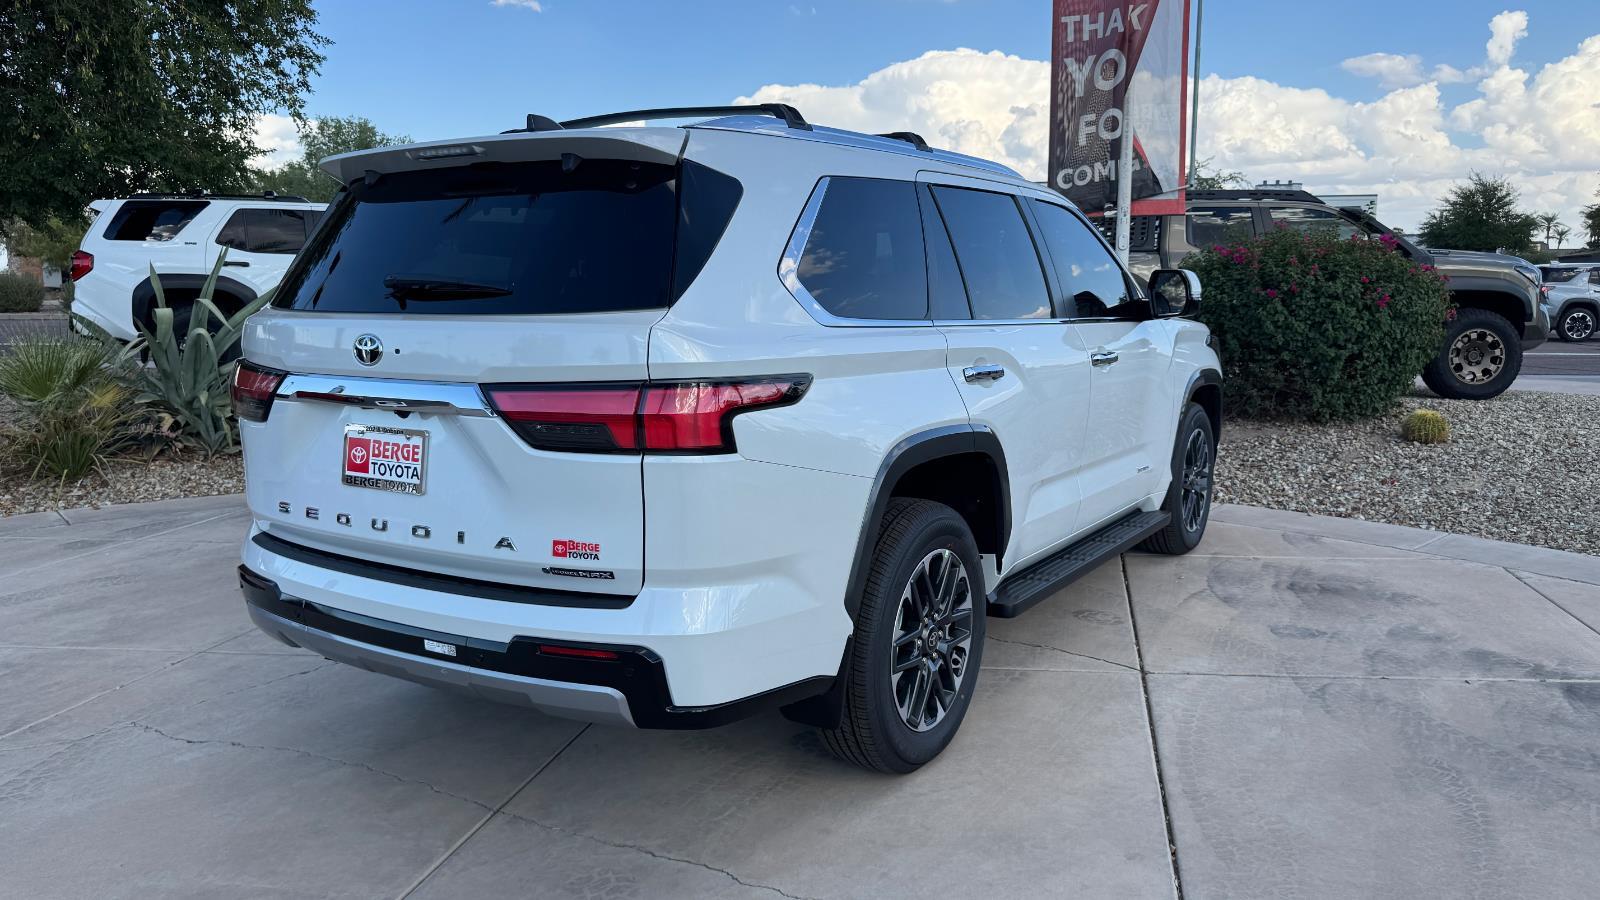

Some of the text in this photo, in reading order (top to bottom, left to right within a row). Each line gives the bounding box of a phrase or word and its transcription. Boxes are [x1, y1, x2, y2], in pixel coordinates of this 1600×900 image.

[1061, 4, 1148, 43] THAK
[1064, 48, 1127, 98] YO
[1078, 107, 1124, 147] FO
[371, 439, 421, 463] BERGE
[371, 462, 420, 480] TOYOTA
[345, 475, 418, 493] BERGE TOYOTA
[278, 501, 518, 552] SEQUOIA
[567, 540, 600, 552] BERGE
[567, 552, 600, 560] TOYOTA
